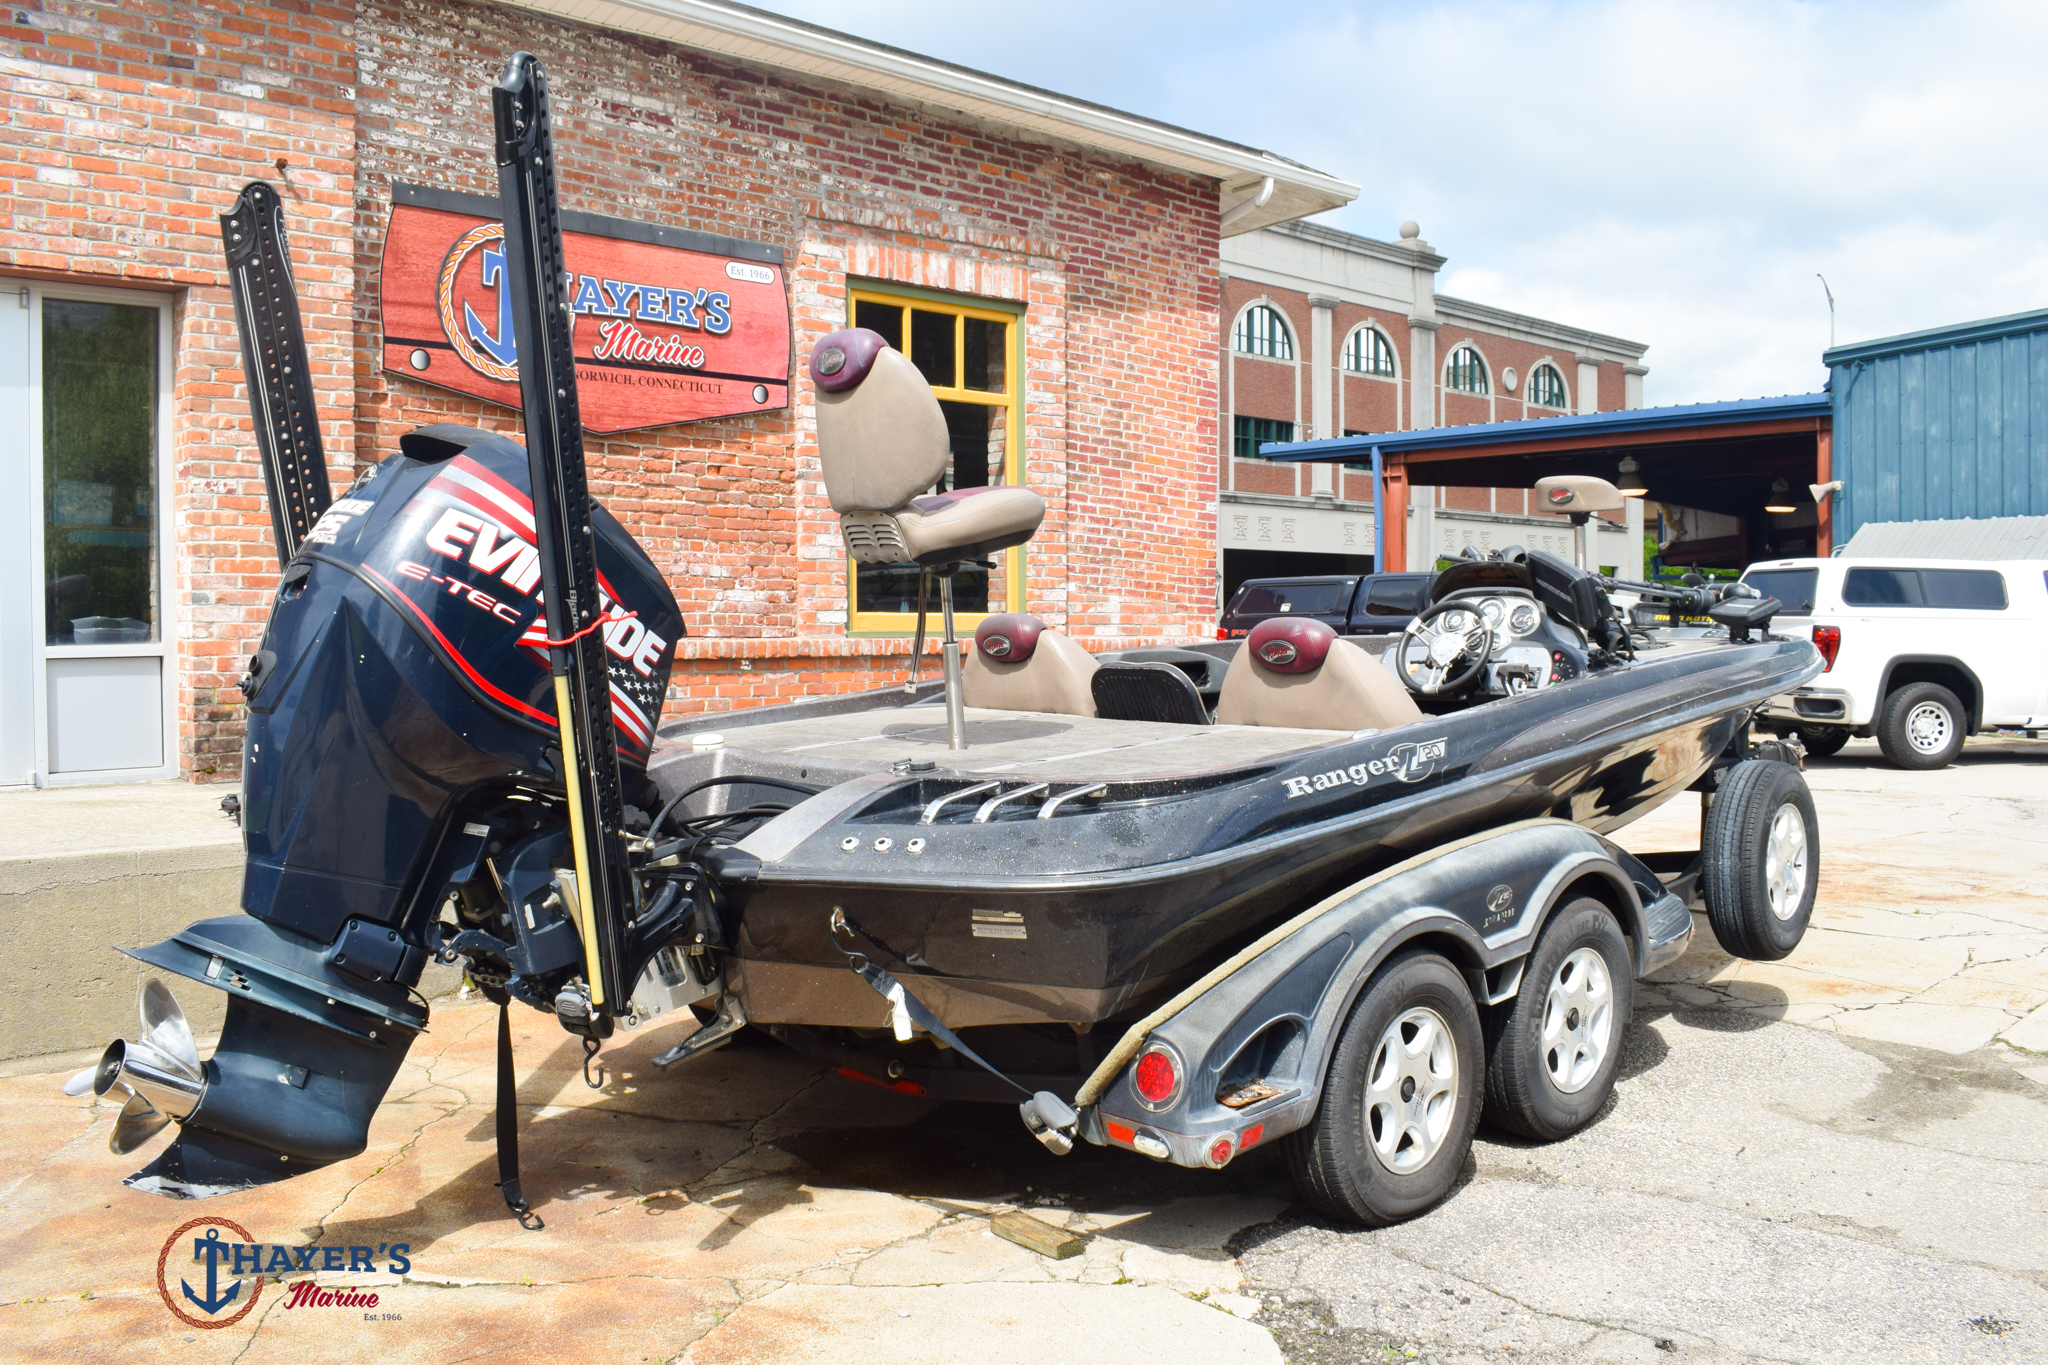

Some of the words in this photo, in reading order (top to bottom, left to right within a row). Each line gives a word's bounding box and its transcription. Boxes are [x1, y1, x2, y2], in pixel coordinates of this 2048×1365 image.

[729, 265, 746, 278] Est.
[749, 267, 771, 281] 1966
[594, 320, 704, 367] Marine
[638, 375, 724, 394] CONNECTICUT
[396, 560, 521, 625] E-TEC
[1265, 643, 1290, 659] Ranger
[1281, 754, 1400, 799] Ranger
